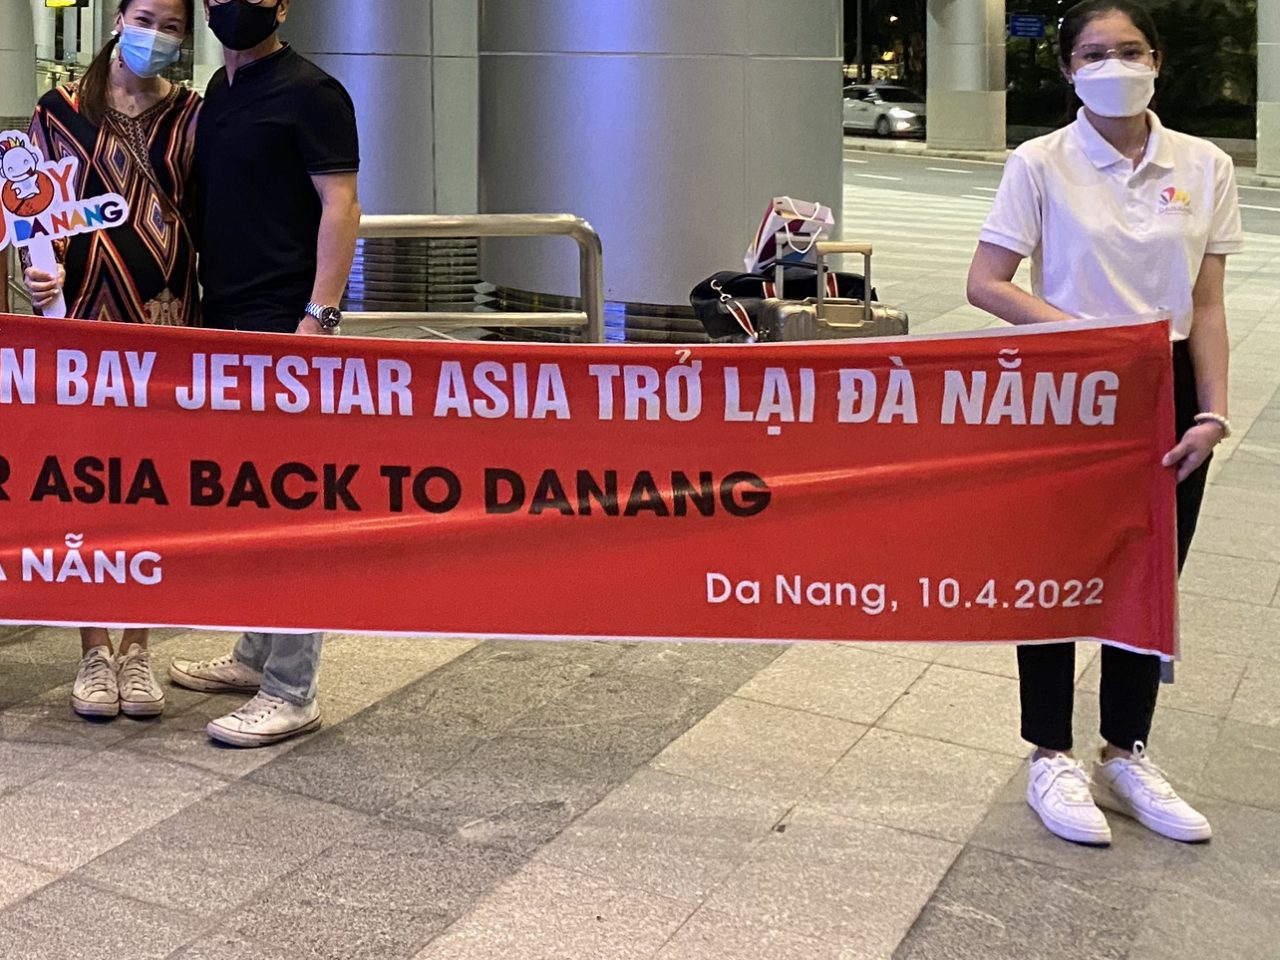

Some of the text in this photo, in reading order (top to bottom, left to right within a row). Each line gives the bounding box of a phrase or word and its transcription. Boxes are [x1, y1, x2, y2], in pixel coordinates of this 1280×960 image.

[56, 348, 156, 407] BAY
[175, 352, 413, 417] JETSTAR
[433, 360, 571, 420] ASIA
[588, 350, 703, 422] TRỞ
[723, 366, 816, 435] LẠI
[837, 355, 918, 425] ĐÀ
[941, 348, 1120, 426] NẴNG
[29, 456, 169, 506] ASIA
[190, 459, 362, 512] BACK
[380, 465, 462, 513] TO
[484, 467, 771, 517] DANANG
[22, 534, 162, 585] NẴNG
[706, 572, 1105, 616] Da Nang, 10.4.2022
